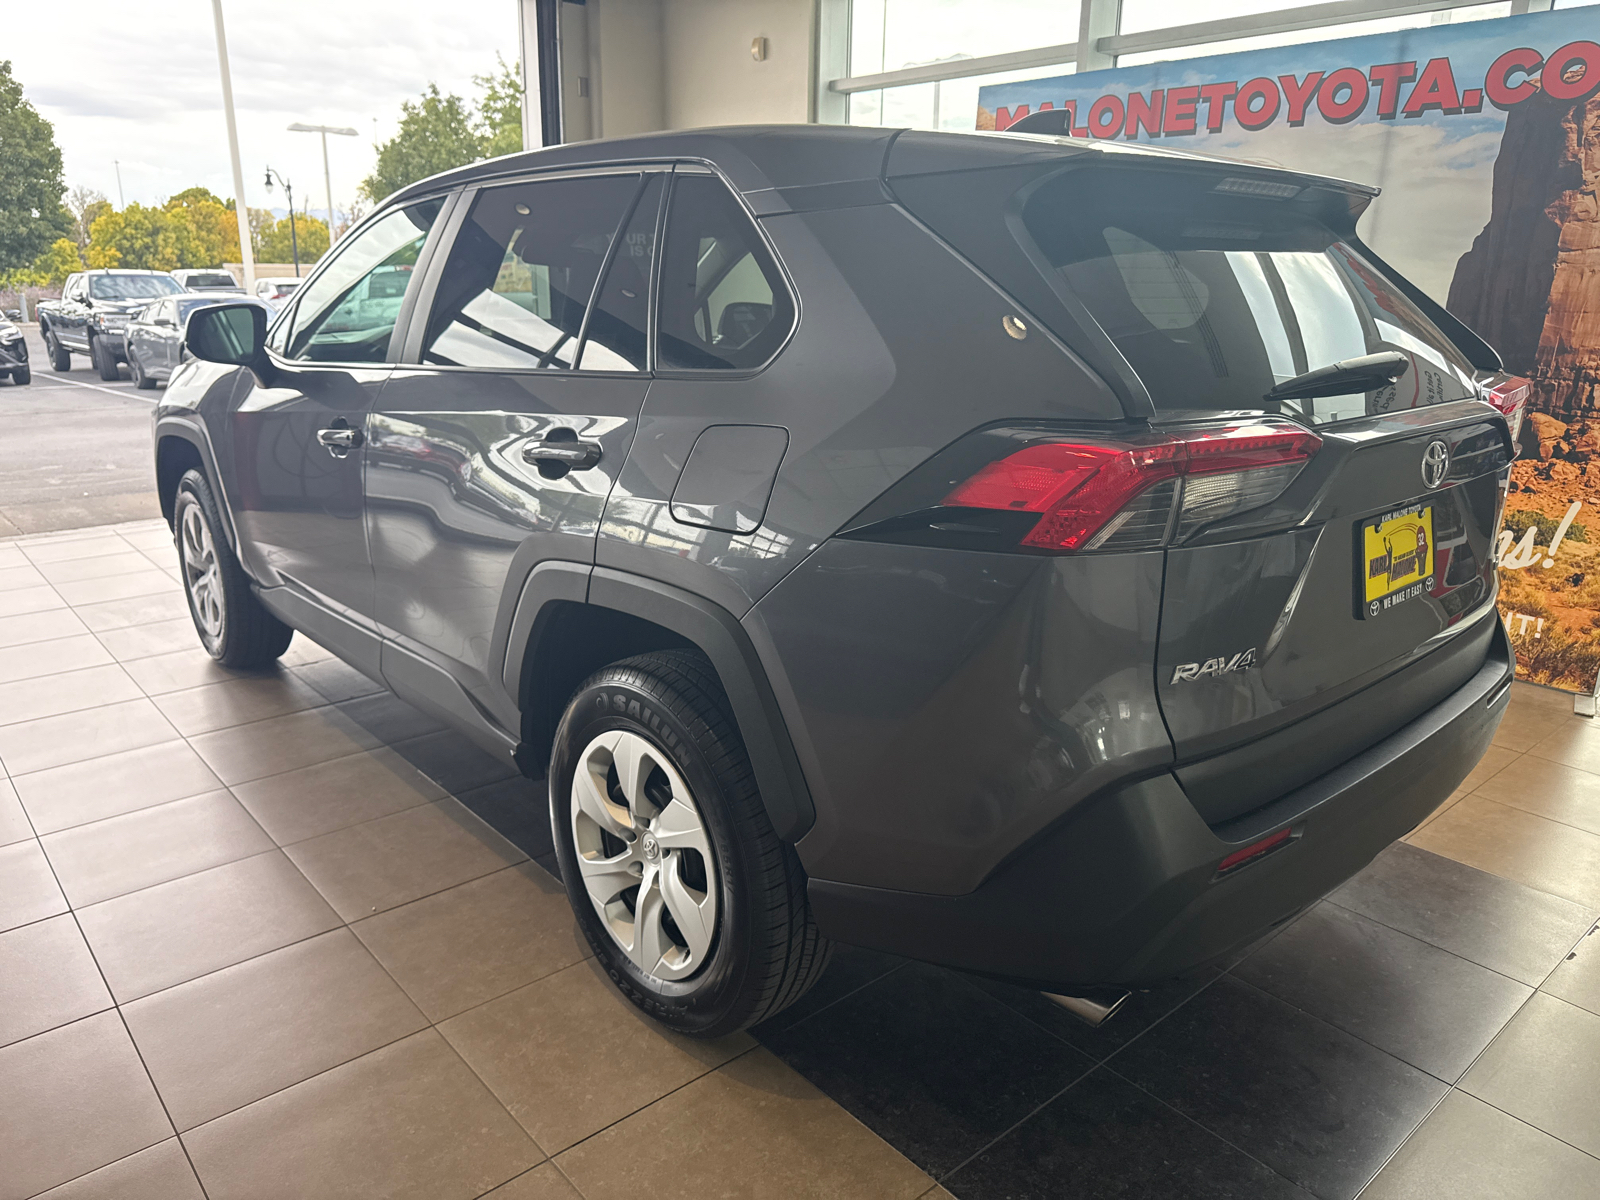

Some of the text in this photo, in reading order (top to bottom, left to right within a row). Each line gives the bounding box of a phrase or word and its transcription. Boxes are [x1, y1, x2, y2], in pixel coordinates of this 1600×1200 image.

[995, 40, 1600, 139] MLONETOYOTA.CO
[606, 233, 647, 245] YUR
[1417, 532, 1425, 546] 32
[1383, 583, 1423, 610] WE MAKE IT EASY
[1169, 647, 1257, 685] RAV4
[613, 694, 693, 768] SAILUN
